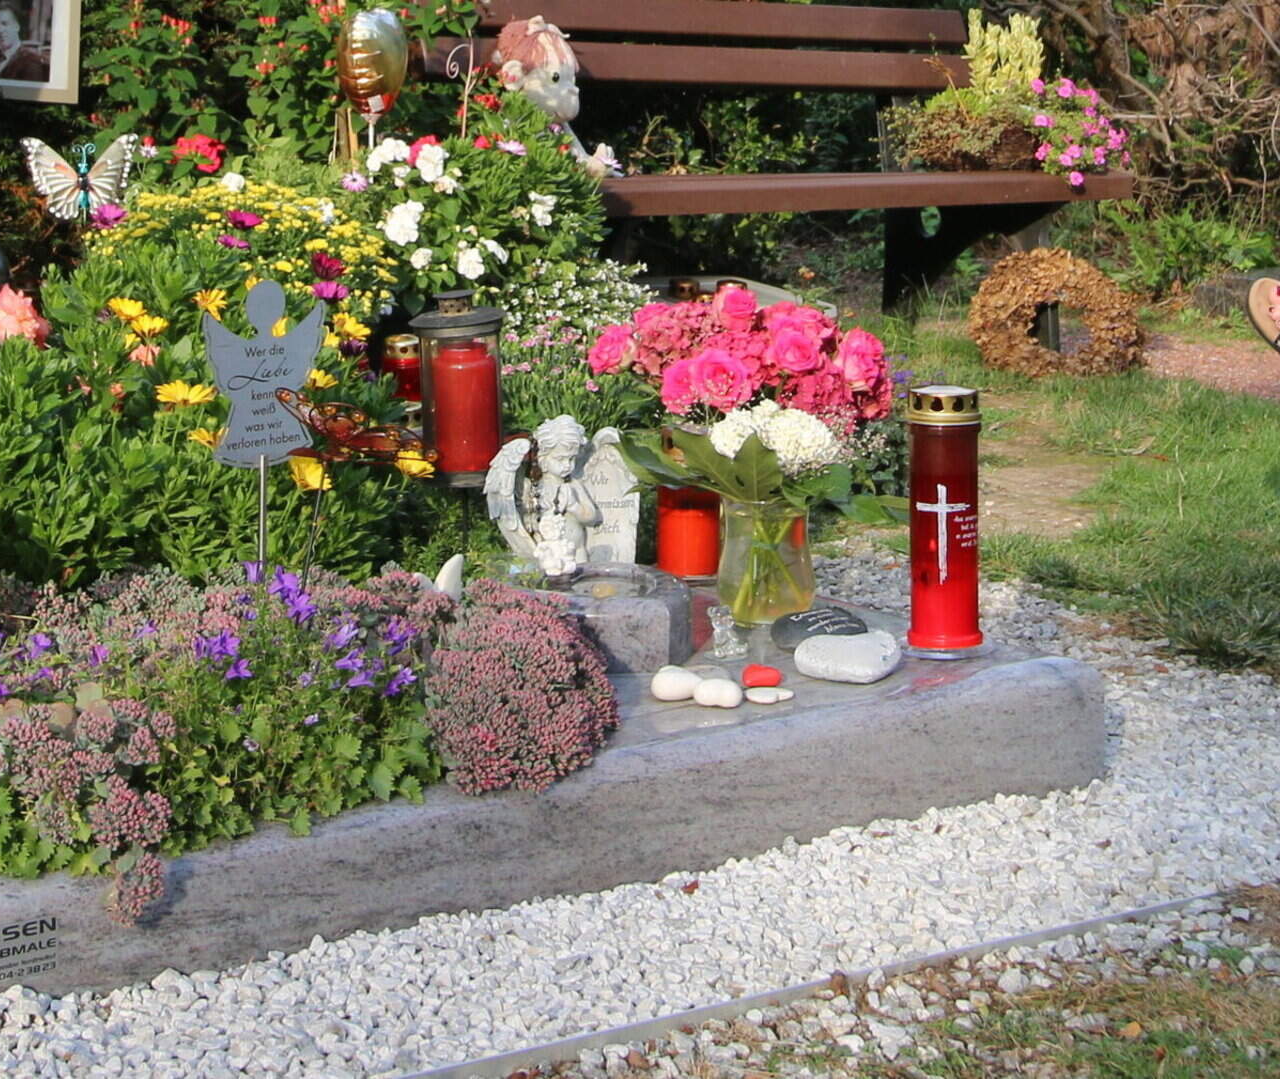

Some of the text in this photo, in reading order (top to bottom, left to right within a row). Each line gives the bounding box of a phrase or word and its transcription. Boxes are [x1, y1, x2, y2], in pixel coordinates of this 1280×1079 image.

[244, 344, 285, 358] Wer die
[227, 357, 296, 391] Liebe
[251, 389, 276, 401] kenn
[251, 401, 277, 417] weiß
[244, 419, 283, 433] was wir
[225, 432, 301, 451] verloren haben
